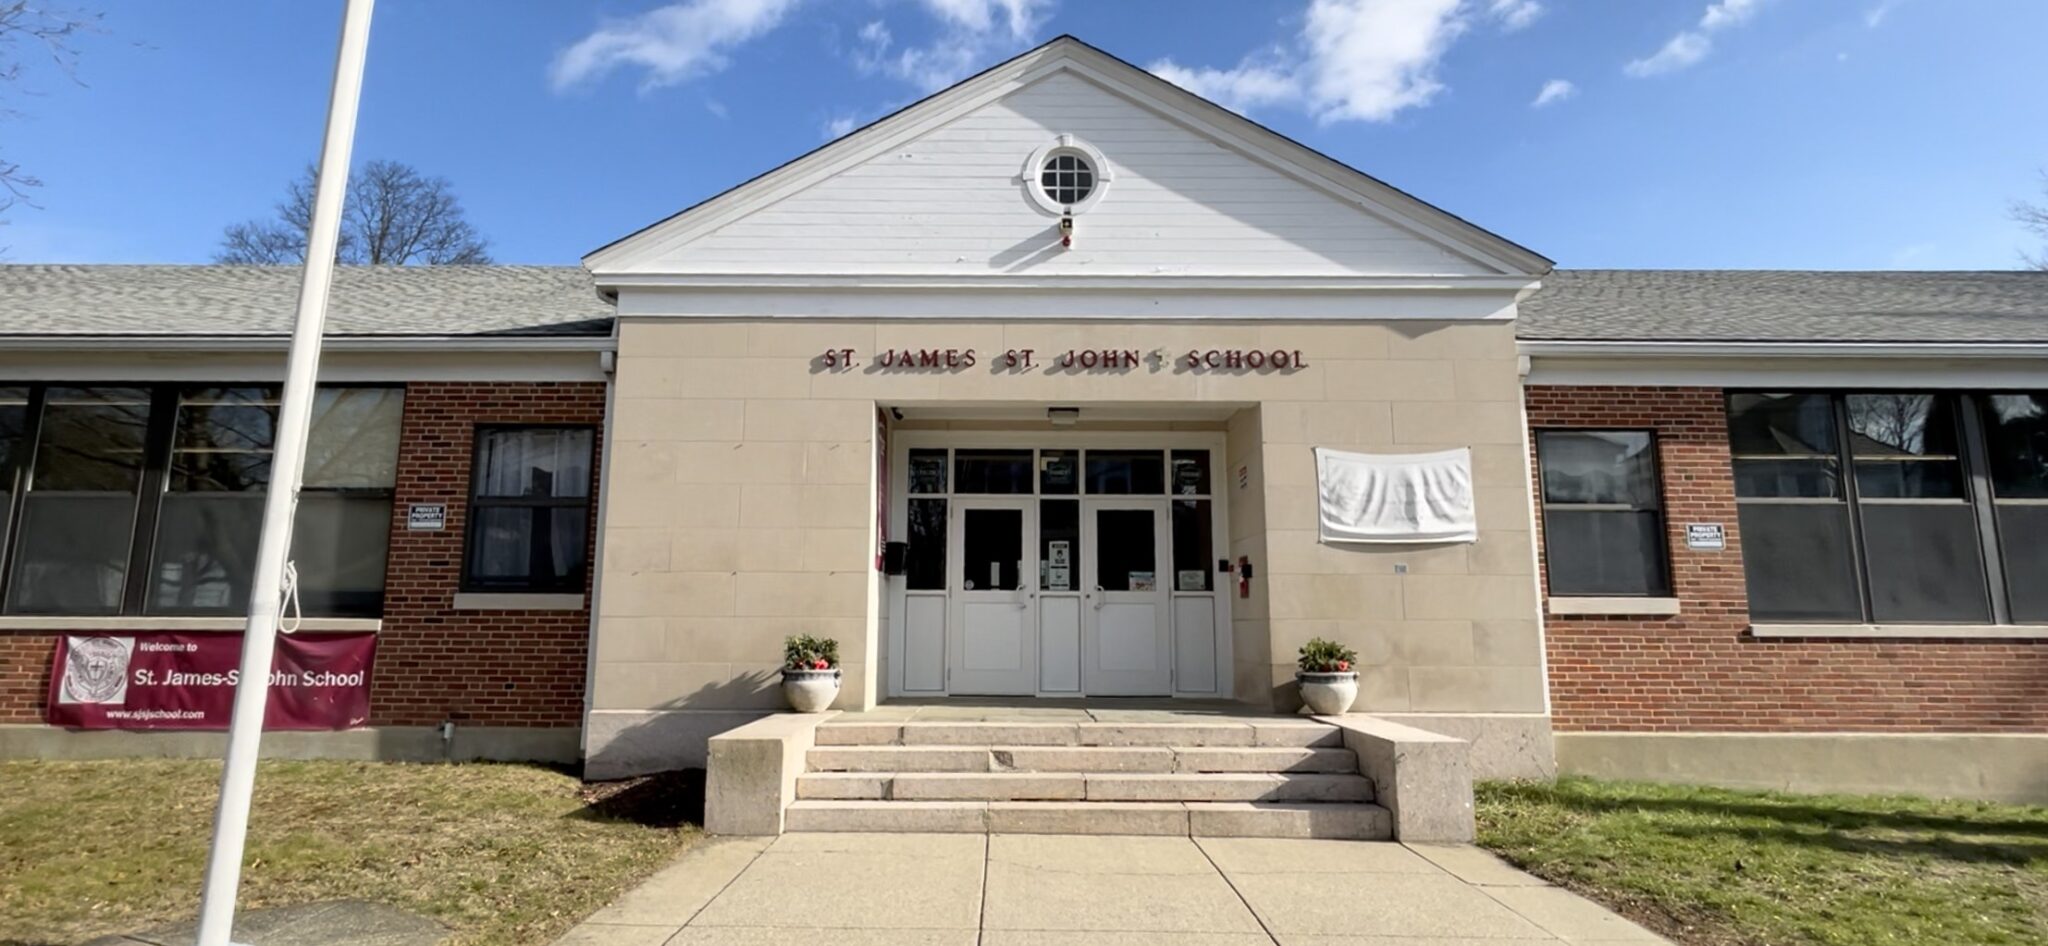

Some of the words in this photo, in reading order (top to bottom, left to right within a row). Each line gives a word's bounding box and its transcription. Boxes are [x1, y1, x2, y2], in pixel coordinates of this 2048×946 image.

[824, 348, 860, 367] ST.
[880, 348, 977, 367] JAMES
[1005, 348, 1040, 367] ST.
[1061, 349, 1139, 368] JOHN
[1187, 349, 1310, 368] SCHOOL
[140, 642, 185, 652] Welcome
[187, 642, 198, 652] to
[134, 669, 158, 686] St.
[162, 669, 239, 687] James-S
[267, 670, 297, 687] ohn
[302, 671, 364, 687] School
[106, 708, 205, 720] www.sjsjschool.com
